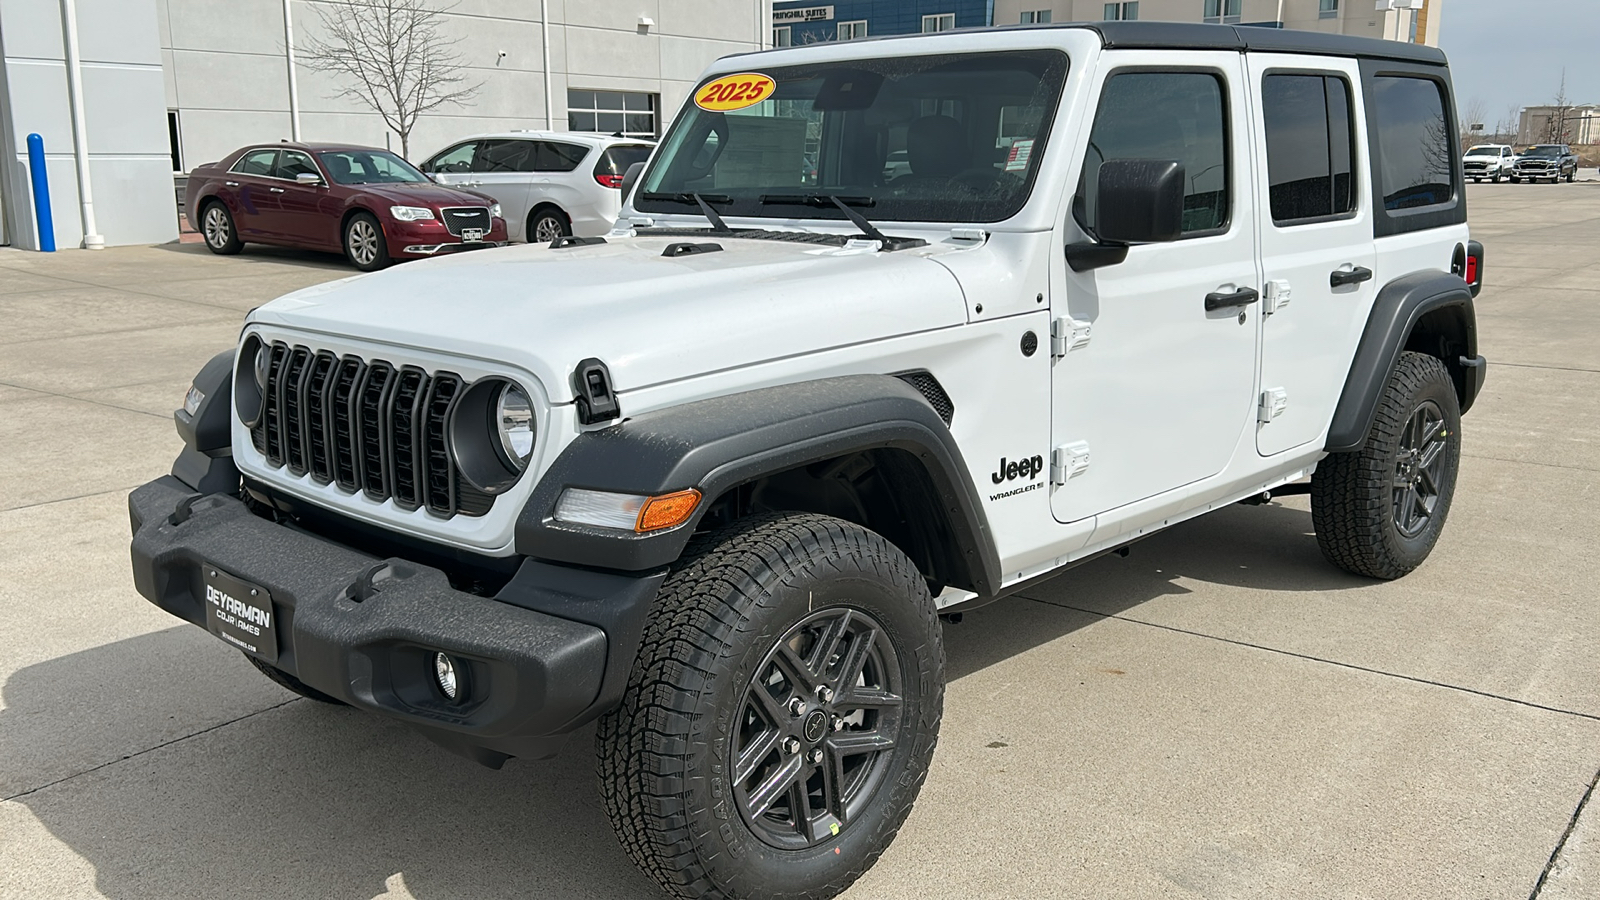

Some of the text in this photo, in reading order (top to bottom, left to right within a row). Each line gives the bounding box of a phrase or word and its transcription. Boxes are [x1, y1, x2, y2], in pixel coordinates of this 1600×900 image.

[773, 10, 804, 19] PRINGHILL
[805, 8, 827, 18] SUITES
[700, 80, 769, 104] 2025
[991, 454, 1043, 484] Jeep
[989, 484, 1036, 501] WRANGLER
[206, 584, 270, 628] DEYARMAN
